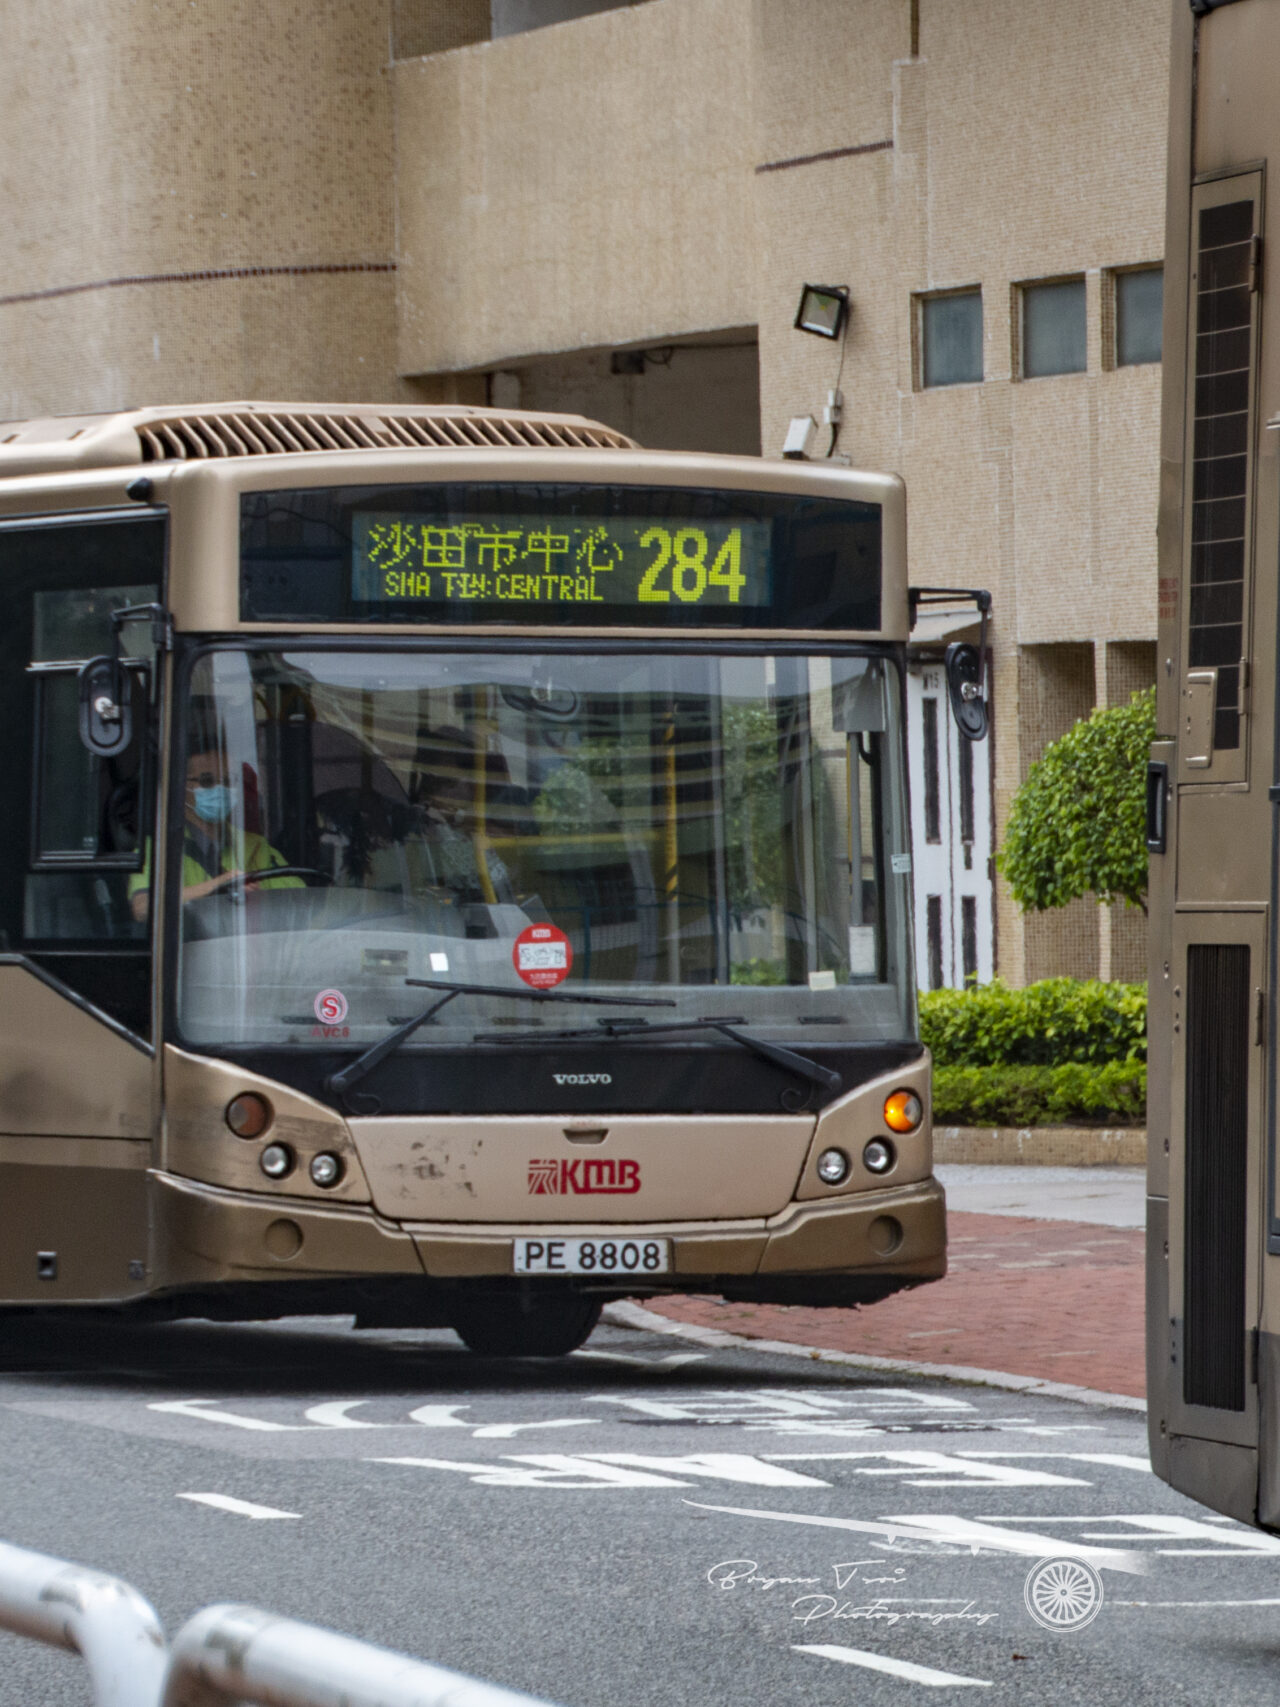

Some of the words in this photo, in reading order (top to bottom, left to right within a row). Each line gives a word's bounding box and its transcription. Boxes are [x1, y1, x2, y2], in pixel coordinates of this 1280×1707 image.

[368, 521, 624, 573] 沙田市中心
[638, 526, 747, 603] 284
[385, 571, 431, 597] SHA
[552, 1073, 613, 1085] VOLVO
[560, 1158, 642, 1195] KMB
[525, 1241, 566, 1270] PE
[578, 1241, 661, 1270] 8808
[360, 1450, 1154, 1488] LEAR
